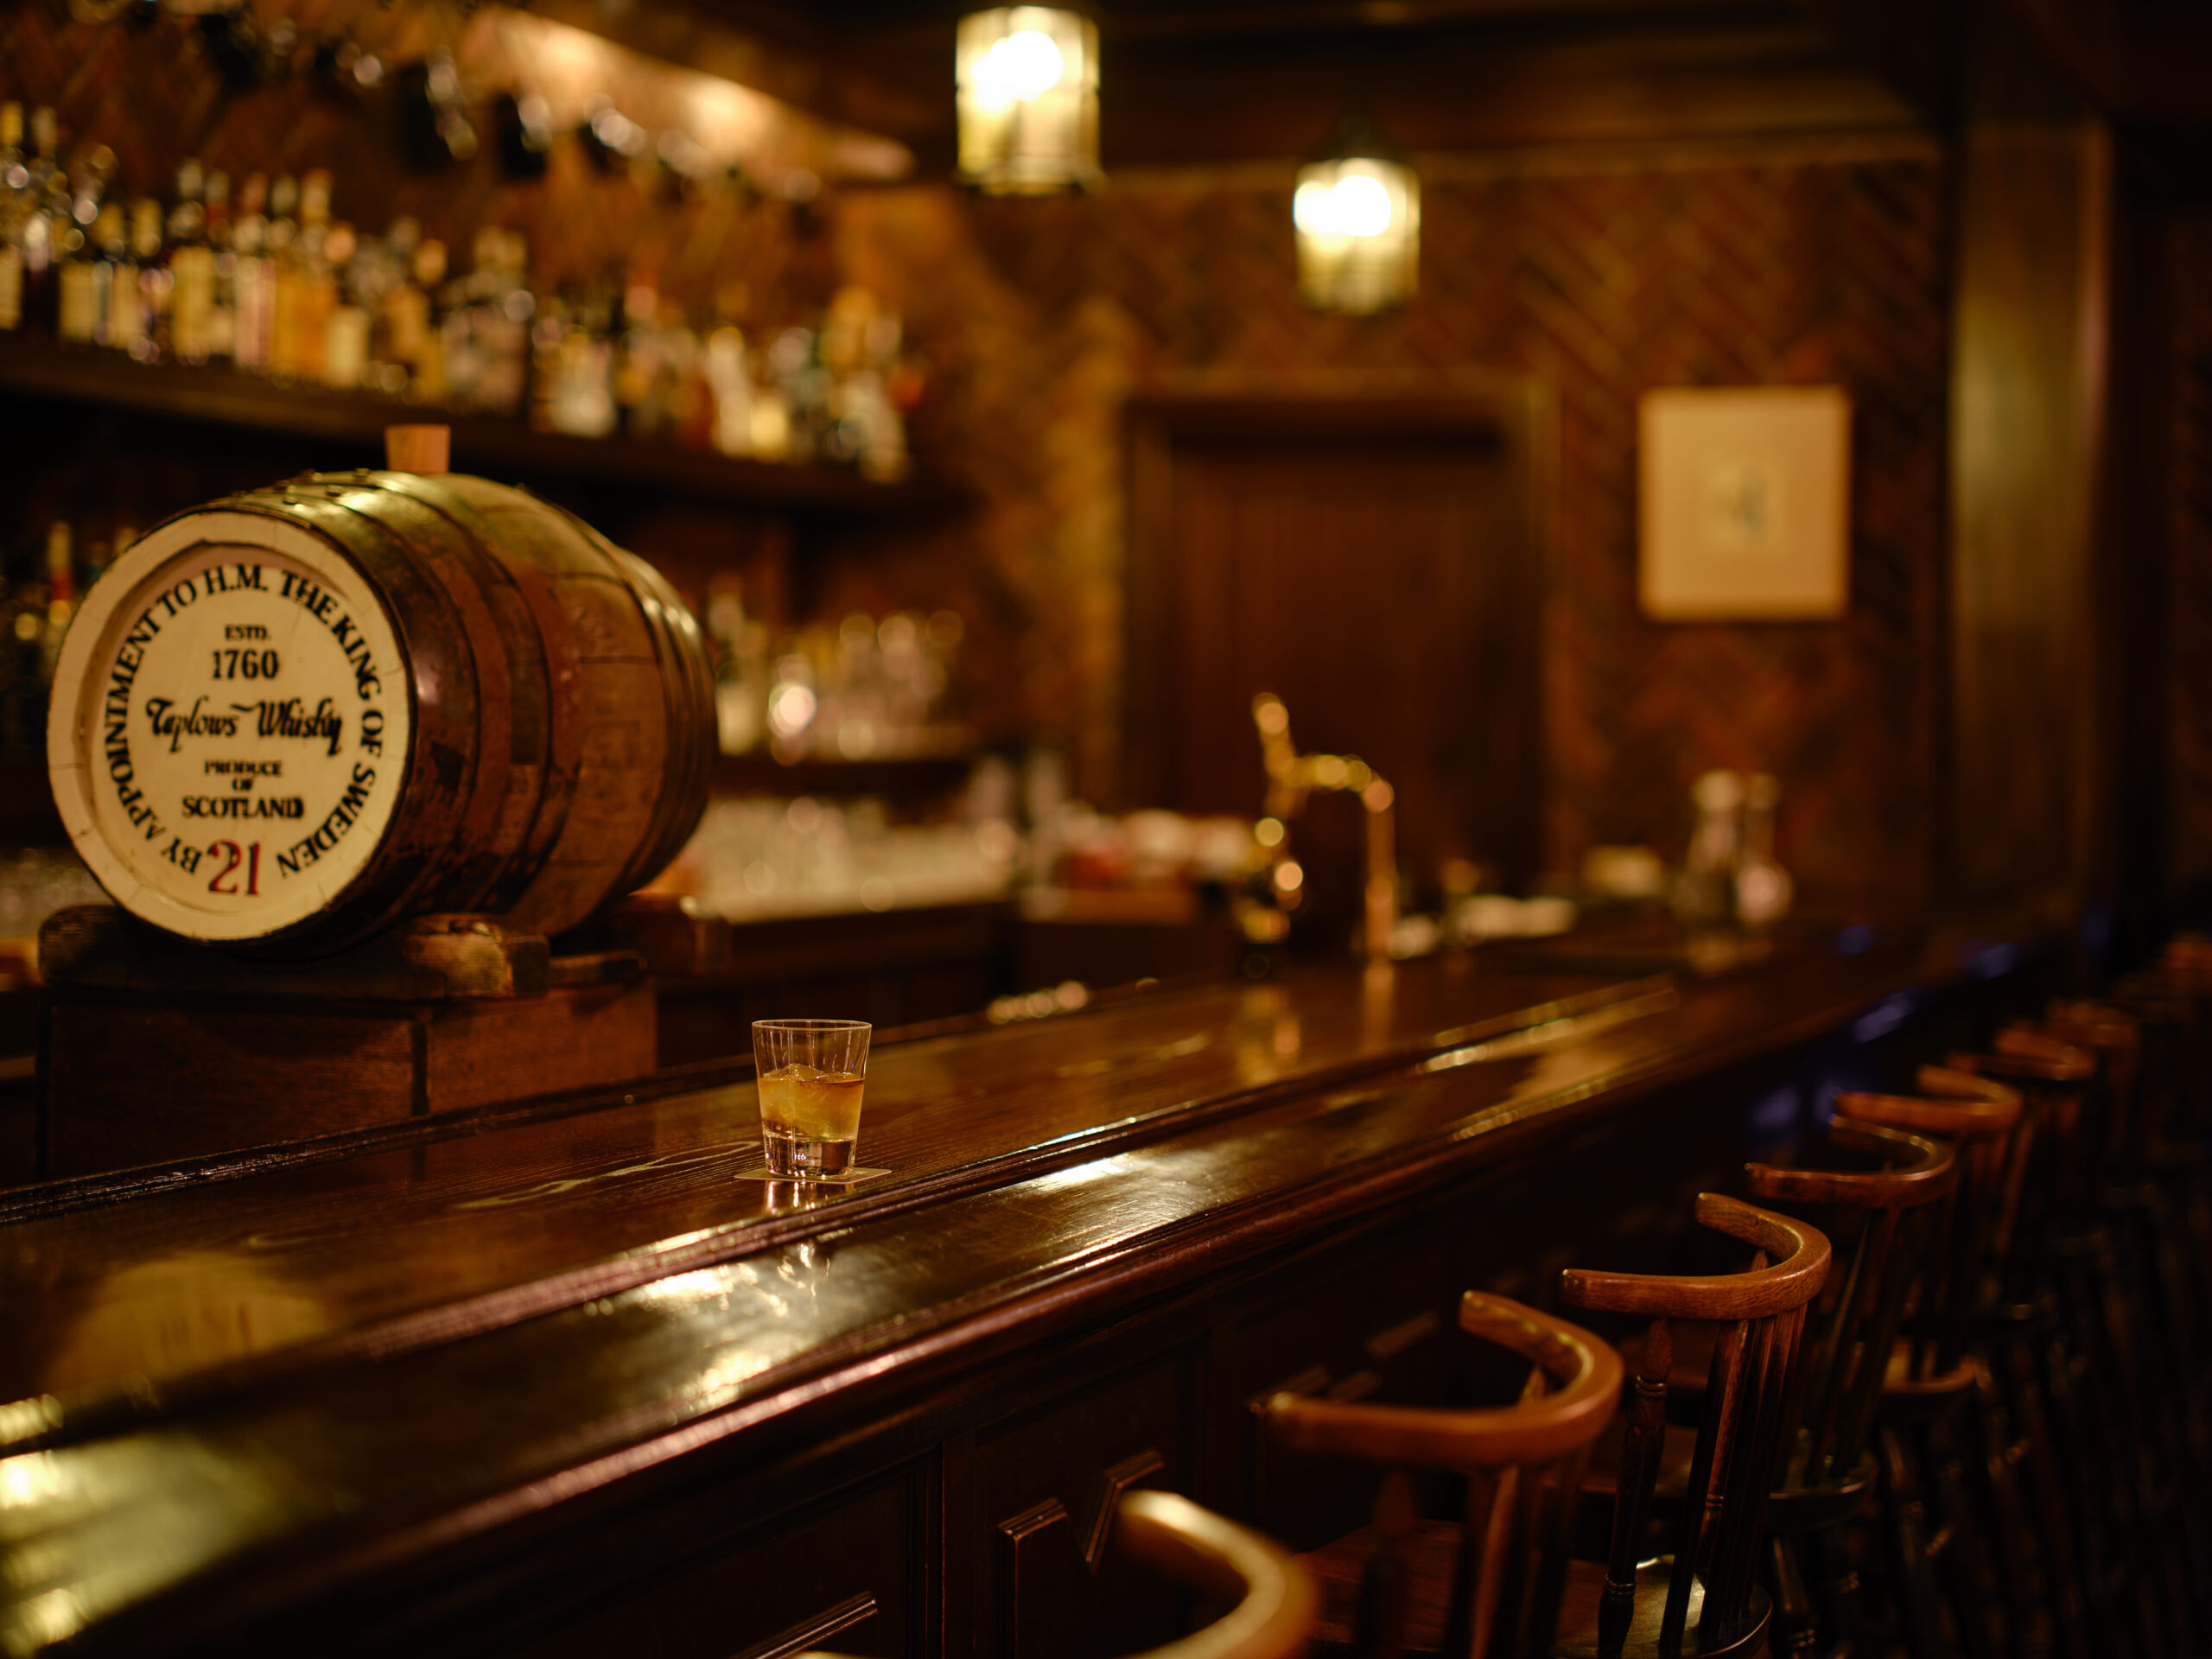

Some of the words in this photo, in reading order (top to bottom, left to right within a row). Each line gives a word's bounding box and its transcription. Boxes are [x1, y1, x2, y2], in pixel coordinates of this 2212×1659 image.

[156, 579, 197, 618] TO
[204, 563, 269, 595] H.M.
[279, 569, 338, 626] THE
[213, 649, 278, 679] 1760
[331, 615, 382, 701] KING
[105, 607, 168, 842] APPOINTMENT
[257, 696, 342, 757] Whisky
[360, 710, 385, 758] OF
[204, 759, 283, 778] PRODUCE
[232, 778, 254, 792] OF
[181, 796, 305, 819] SCOTLAND
[276, 763, 377, 879] SWEDEN
[161, 838, 202, 875] BY
[207, 838, 262, 896] 21
